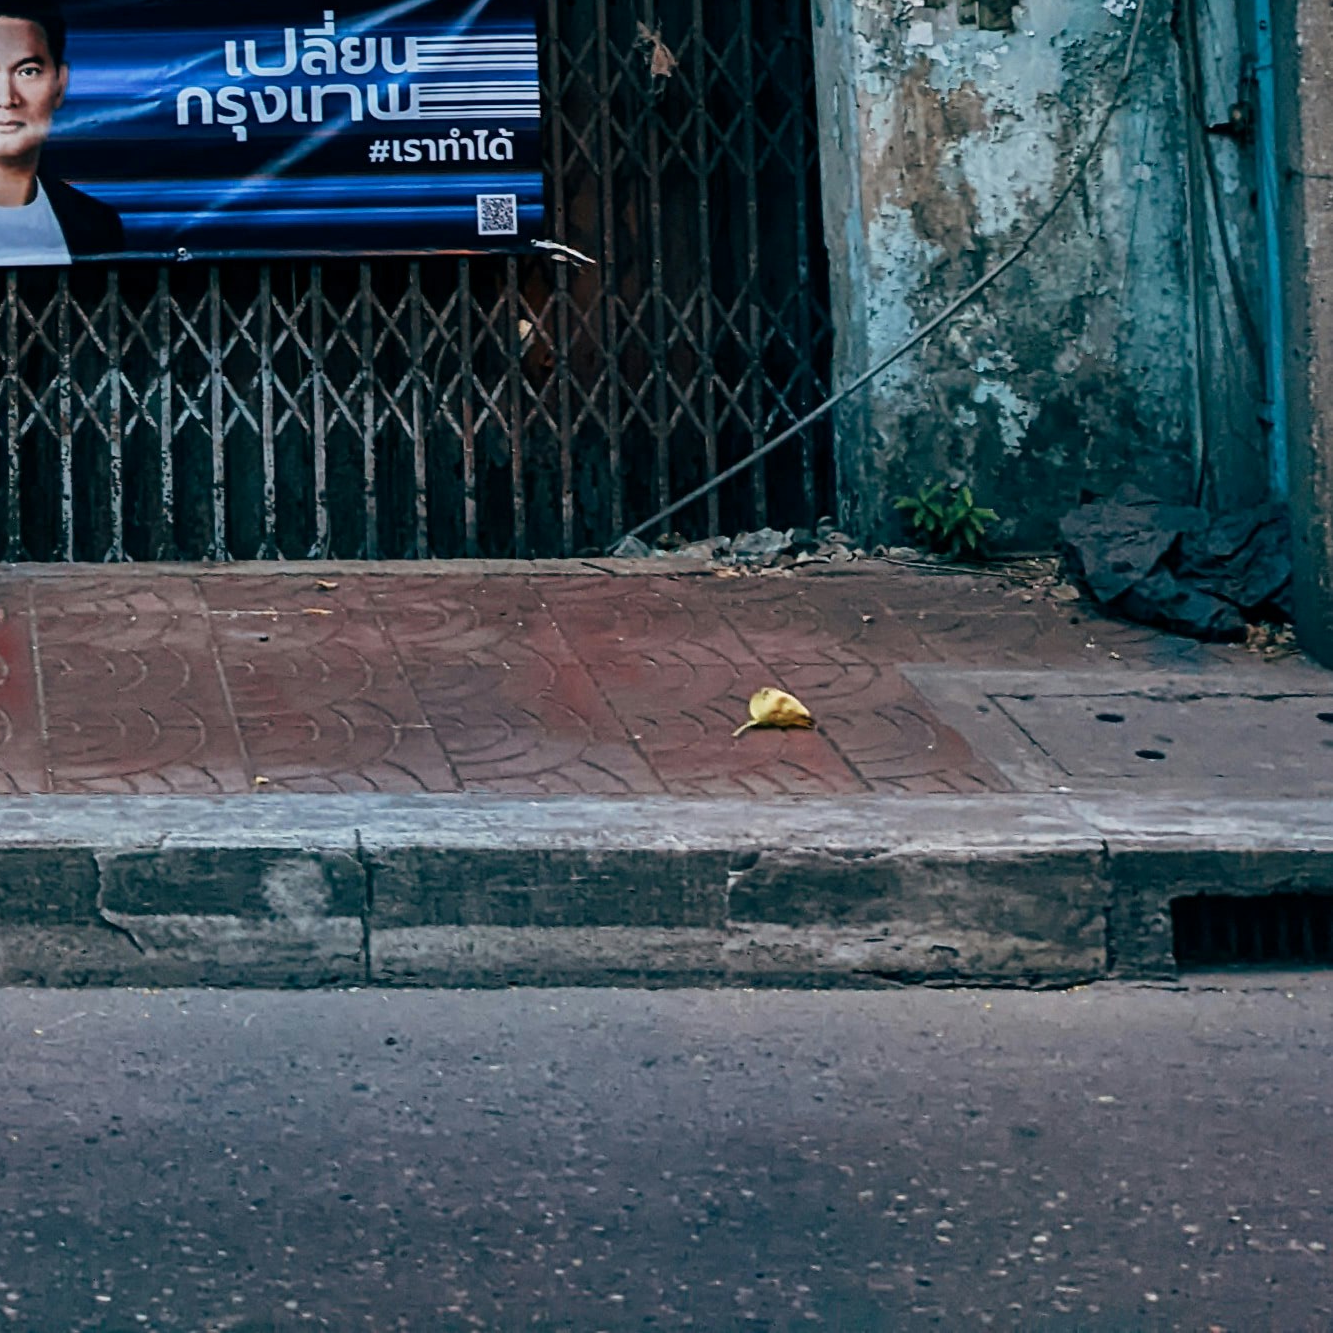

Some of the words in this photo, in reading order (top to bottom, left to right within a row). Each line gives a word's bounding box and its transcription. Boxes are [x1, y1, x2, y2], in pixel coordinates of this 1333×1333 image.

[224, 9, 419, 77] เปลี่ยน
[176, 81, 421, 142] กรุงเทพ
[368, 127, 515, 164] #เราทำได้
